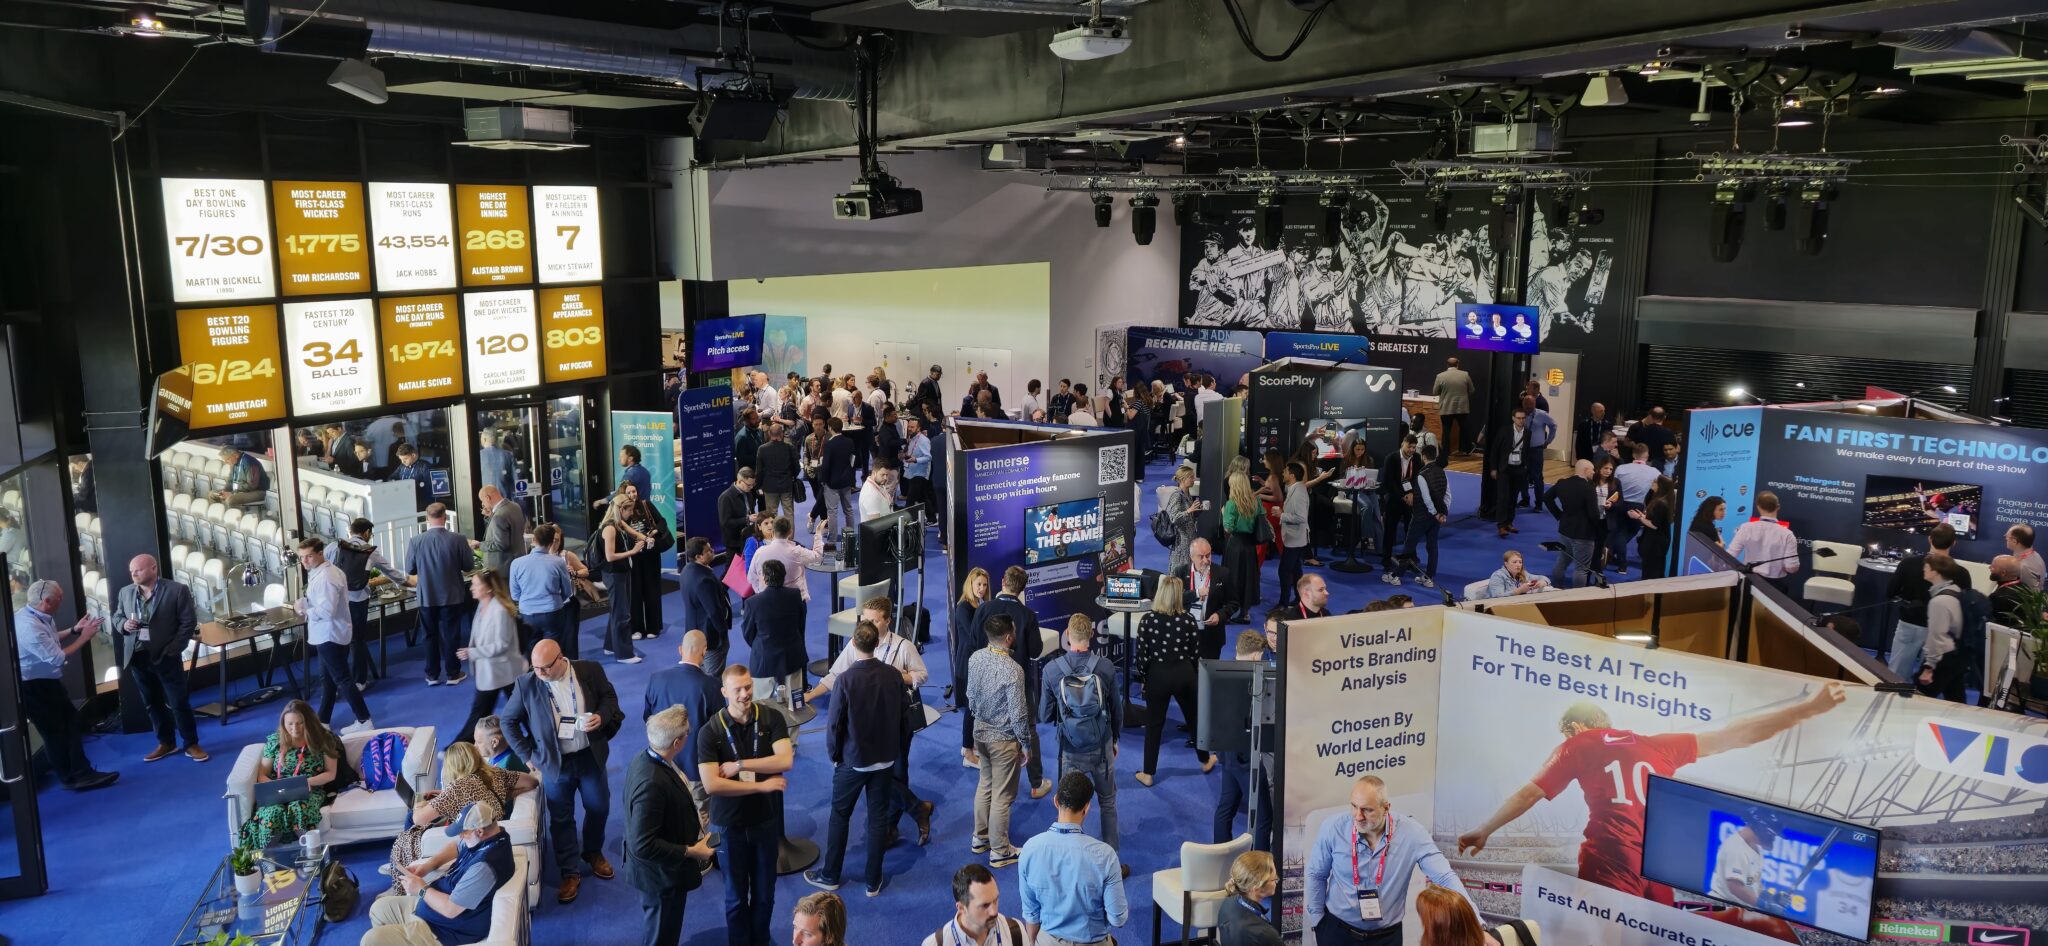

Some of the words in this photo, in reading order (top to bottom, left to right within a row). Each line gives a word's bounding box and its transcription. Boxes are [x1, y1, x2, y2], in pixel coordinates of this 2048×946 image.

[194, 189, 216, 198] BEST
[219, 189, 236, 198] ONE
[291, 190, 314, 198] MOST
[316, 190, 347, 200] CAREER
[386, 192, 407, 200] MOST
[408, 192, 435, 200] CAREER
[479, 192, 506, 201] HIGHEST
[186, 200, 202, 208] DAY
[206, 199, 246, 208] BOWLING
[294, 200, 345, 209] FIRST-CLASS
[389, 200, 433, 208] FIRST-CLASS
[480, 201, 493, 210] ONE
[494, 201, 507, 210] DAY
[199, 209, 236, 218] FIGURES
[302, 209, 339, 218] WICKETS
[402, 210, 422, 218] RUNS
[480, 209, 508, 218] INNINGS
[378, 235, 450, 250] 43,554
[466, 229, 525, 251] 268
[556, 225, 580, 250] 7
[175, 234, 264, 259] 7/30
[285, 234, 360, 256] 1,775
[472, 266, 499, 276] ALISTAIR
[500, 265, 524, 274] BROWN
[568, 262, 594, 270] STEWART
[292, 274, 310, 282] TOM
[312, 272, 360, 282] RICHARDSON
[396, 270, 412, 278] JACK
[414, 268, 438, 277] HOBBS
[186, 278, 220, 287] MARTIN
[222, 276, 262, 286] BICKNELL
[480, 300, 496, 308] MOST
[498, 298, 521, 306] CAREER
[564, 294, 580, 302] MOST
[396, 304, 415, 314] MOST
[416, 302, 443, 312] CAREER
[489, 308, 500, 316] DAY
[501, 306, 527, 315] WICKETS
[562, 302, 584, 310] CAREER
[304, 310, 338, 319] FASTEST
[340, 308, 354, 318] T20
[395, 314, 410, 323] ONE
[411, 313, 424, 322] DAY
[426, 312, 444, 321] RUNS
[553, 310, 592, 319] APPEARANCES
[206, 316, 230, 326] BEST
[232, 316, 250, 326] T20
[312, 318, 348, 328] CENTURY
[209, 325, 250, 336] BOWLING
[212, 335, 249, 346] FIGURES
[546, 326, 602, 349] 803
[476, 333, 529, 356] 120
[708, 346, 725, 356] Pitch
[726, 344, 750, 354] access
[1144, 338, 1207, 351] RECHARGE
[1208, 342, 1242, 353] HERE
[1292, 342, 1320, 350] SportsPro
[1320, 343, 1340, 351] LIVE
[1377, 342, 1417, 353] GREATEST
[1420, 344, 1429, 354] XI
[302, 338, 363, 368] 34
[389, 339, 456, 364] 1,974
[192, 358, 276, 385] 6/24
[560, 363, 572, 372] PAT
[572, 360, 592, 370] POCOCK
[312, 367, 358, 380] BALLS
[398, 380, 426, 391] NATALIE
[428, 377, 452, 388] SCIVER
[1259, 374, 1316, 388] ScorePlay
[311, 391, 332, 401] SEAN
[334, 388, 362, 399] ABBOTT
[206, 403, 224, 414] TIM
[226, 399, 267, 412] MURTAGH
[684, 402, 711, 414] SportsPro
[712, 396, 730, 408] LIVE
[647, 422, 667, 430] LIVE
[1722, 422, 1755, 438] cue
[624, 434, 664, 442] Sponsorship
[1784, 424, 1832, 444] FAN
[1836, 428, 1904, 450] FIRST
[1909, 434, 2048, 464] TECHNOLO
[974, 456, 1030, 471] bannerse
[1836, 448, 1854, 457] We
[1855, 450, 1884, 461] make
[1886, 453, 1916, 465] every
[1917, 455, 1936, 466] fan
[1937, 458, 1960, 471] part
[1962, 459, 1975, 469] of
[1976, 461, 1994, 472] the
[1996, 463, 2028, 474] show
[975, 480, 1017, 492] Interactive
[1018, 476, 1051, 487] gameday
[1052, 472, 1080, 482] fanzone
[1810, 477, 1840, 486] largest
[1841, 480, 1856, 488] fan
[975, 493, 991, 502] web
[992, 492, 1008, 501] app
[1009, 488, 1034, 497] within
[1035, 485, 1058, 494] hours
[1768, 481, 1818, 492] engagement
[1819, 486, 1855, 496] platform
[1824, 496, 1854, 504] events.
[1998, 498, 2032, 508] Engage
[1997, 506, 2034, 516] Capture
[1034, 515, 1082, 534] YOU'RE
[1083, 513, 1096, 526] IN
[1996, 514, 2028, 524] Elevate
[1036, 534, 1060, 548] THE
[1062, 526, 1104, 544] GAME!
[1340, 627, 1412, 648] Visual-AI
[1312, 655, 1364, 676] Sports
[1368, 647, 1437, 667] Branding
[1496, 634, 1536, 659] The
[1542, 641, 1592, 673] Best
[1598, 654, 1622, 676] AI
[1627, 660, 1688, 690] Tech
[1341, 670, 1407, 691] Analysis
[1472, 654, 1506, 678] For
[1513, 662, 1552, 687] The
[1557, 673, 1609, 700] Best
[1615, 682, 1713, 723] Insights
[1331, 715, 1390, 734] Chosen
[1394, 712, 1413, 728] By
[1316, 738, 1362, 758] World
[1366, 731, 1426, 750] Leading
[1335, 754, 1406, 778] Agencies
[1604, 760, 1656, 807] 10
[1838, 901, 1858, 916] 34
[1538, 886, 1573, 908] Fast
[1576, 899, 1610, 921] And
[1615, 911, 1696, 944] Accurate
[1878, 922, 1938, 938] Heineken
